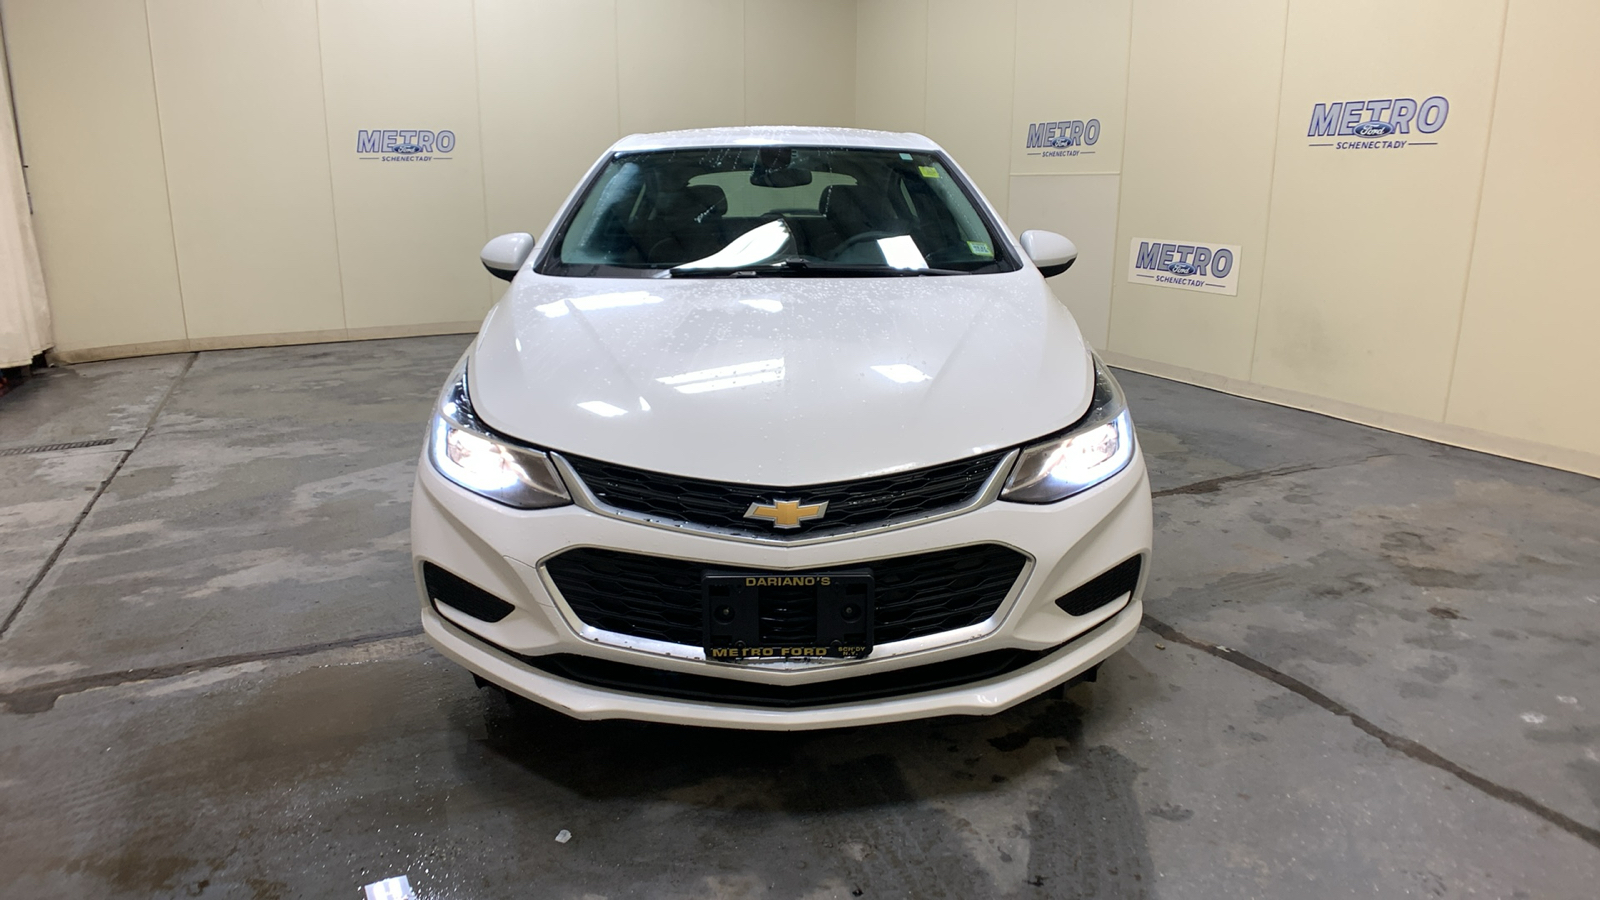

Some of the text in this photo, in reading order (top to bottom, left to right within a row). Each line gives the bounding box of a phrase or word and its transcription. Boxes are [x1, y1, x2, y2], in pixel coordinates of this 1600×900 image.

[1307, 96, 1449, 137] METRO
[1026, 118, 1101, 149] METRO
[1360, 124, 1385, 135] Ford
[356, 129, 456, 153] METRO
[1335, 140, 1407, 150] SCHENECTADY
[1135, 241, 1233, 278] METRO
[1155, 275, 1205, 287] SCHENECTADY
[745, 577, 831, 587] DARIANO'S
[712, 647, 828, 657] METRO FORD
